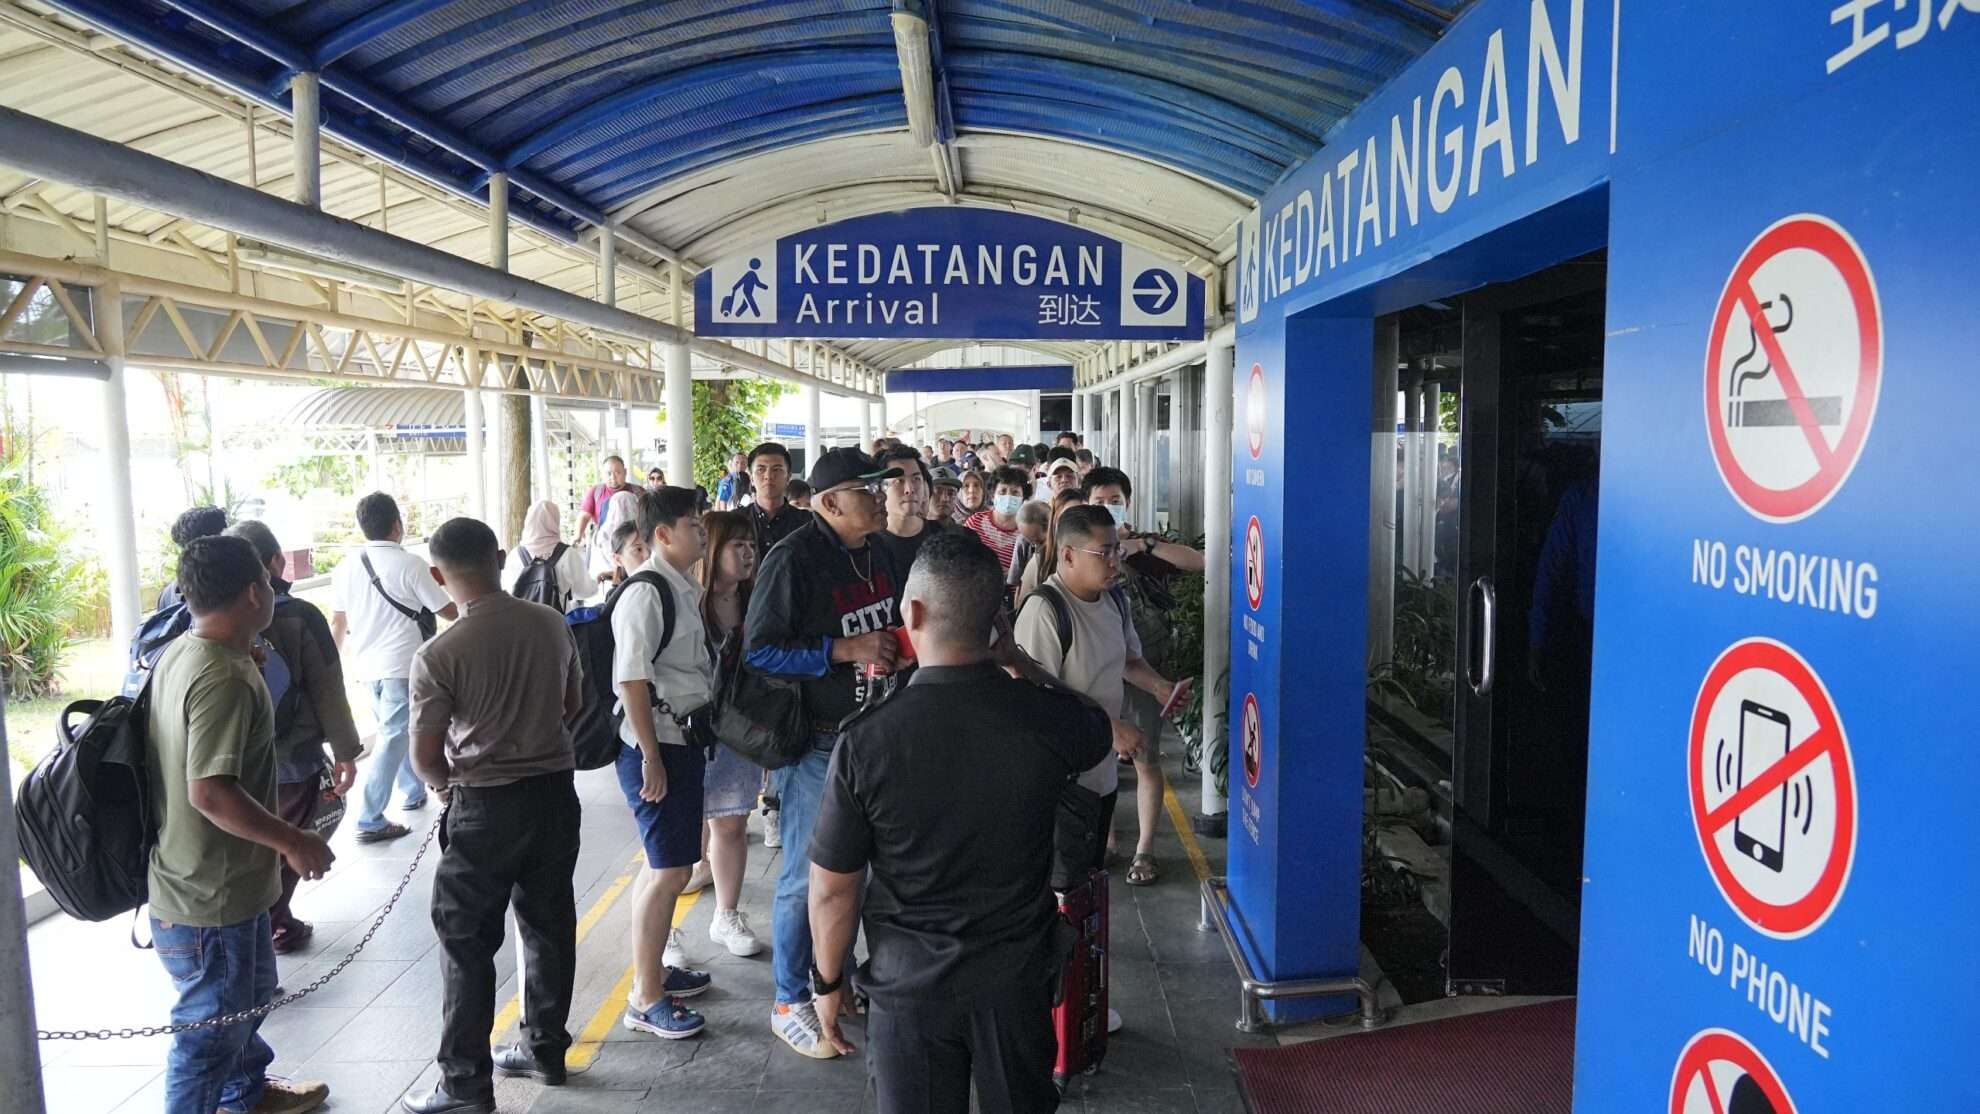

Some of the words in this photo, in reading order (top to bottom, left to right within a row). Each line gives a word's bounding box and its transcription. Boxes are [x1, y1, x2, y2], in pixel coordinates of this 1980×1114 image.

[1264, 0, 1584, 303] KEDATANGAN
[795, 244, 1103, 286] KEDATANGAN
[796, 293, 938, 325] Arrival
[1038, 294, 1101, 325] 到达
[1692, 538, 1727, 589] NO
[1733, 545, 1879, 619] SMOKING
[841, 597, 894, 638] CITY
[1689, 914, 1724, 976] NO
[1730, 943, 1832, 1059] PHONE
